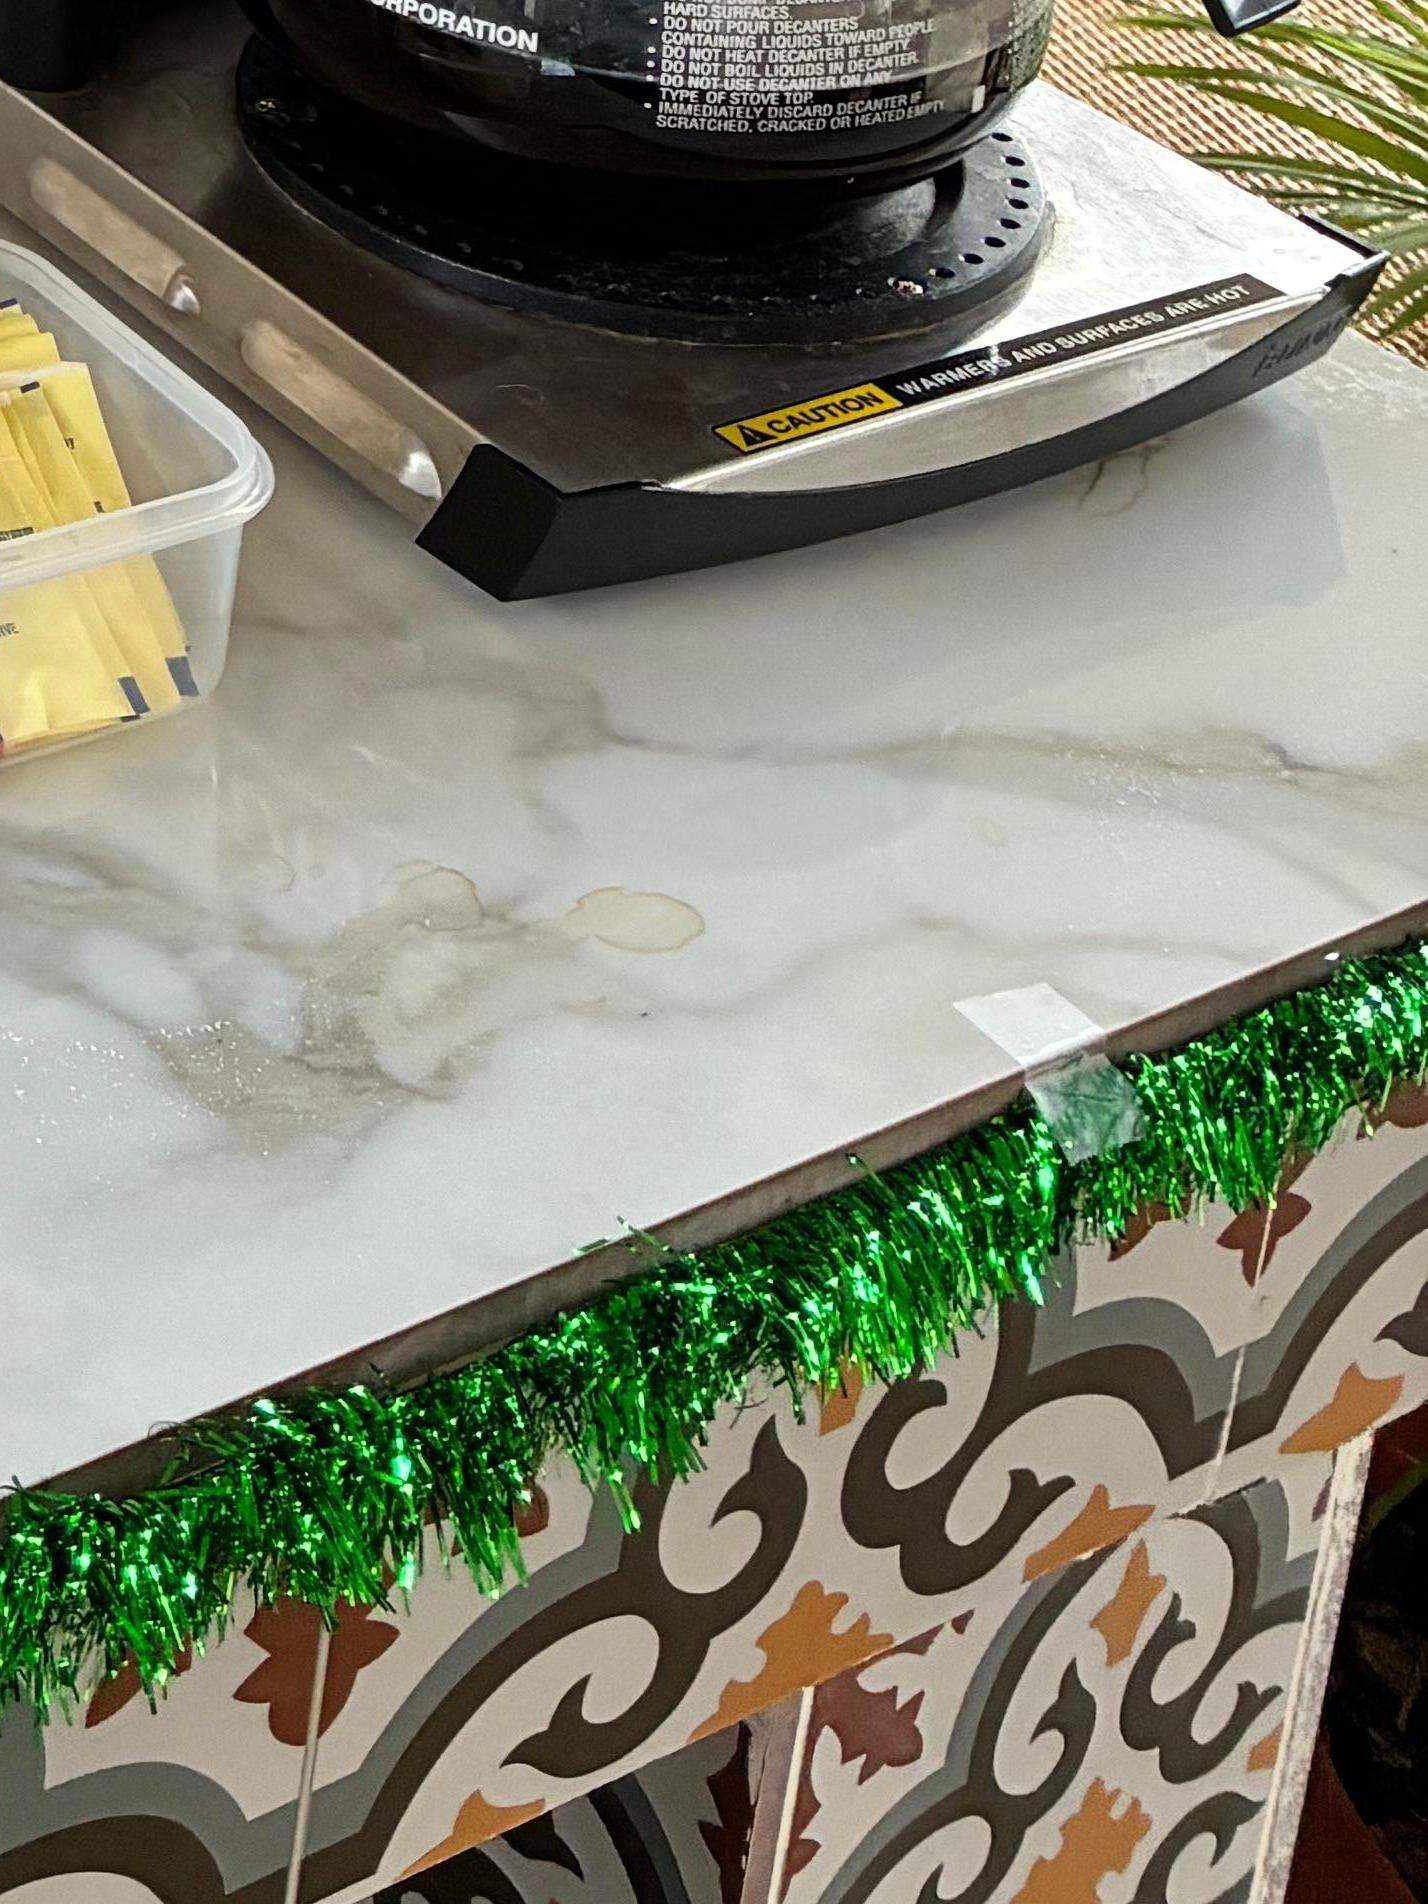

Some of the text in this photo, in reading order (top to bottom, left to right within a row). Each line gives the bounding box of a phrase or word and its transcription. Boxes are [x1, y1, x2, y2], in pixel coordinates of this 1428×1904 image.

[658, 94, 907, 120] IMMEDIATELY DISCARD DECANTER
[656, 115, 850, 134] SCRATCHED, CRACKED OR
[770, 282, 1250, 435] CAUTION WARMERS AND SURFACES ARE HOT
